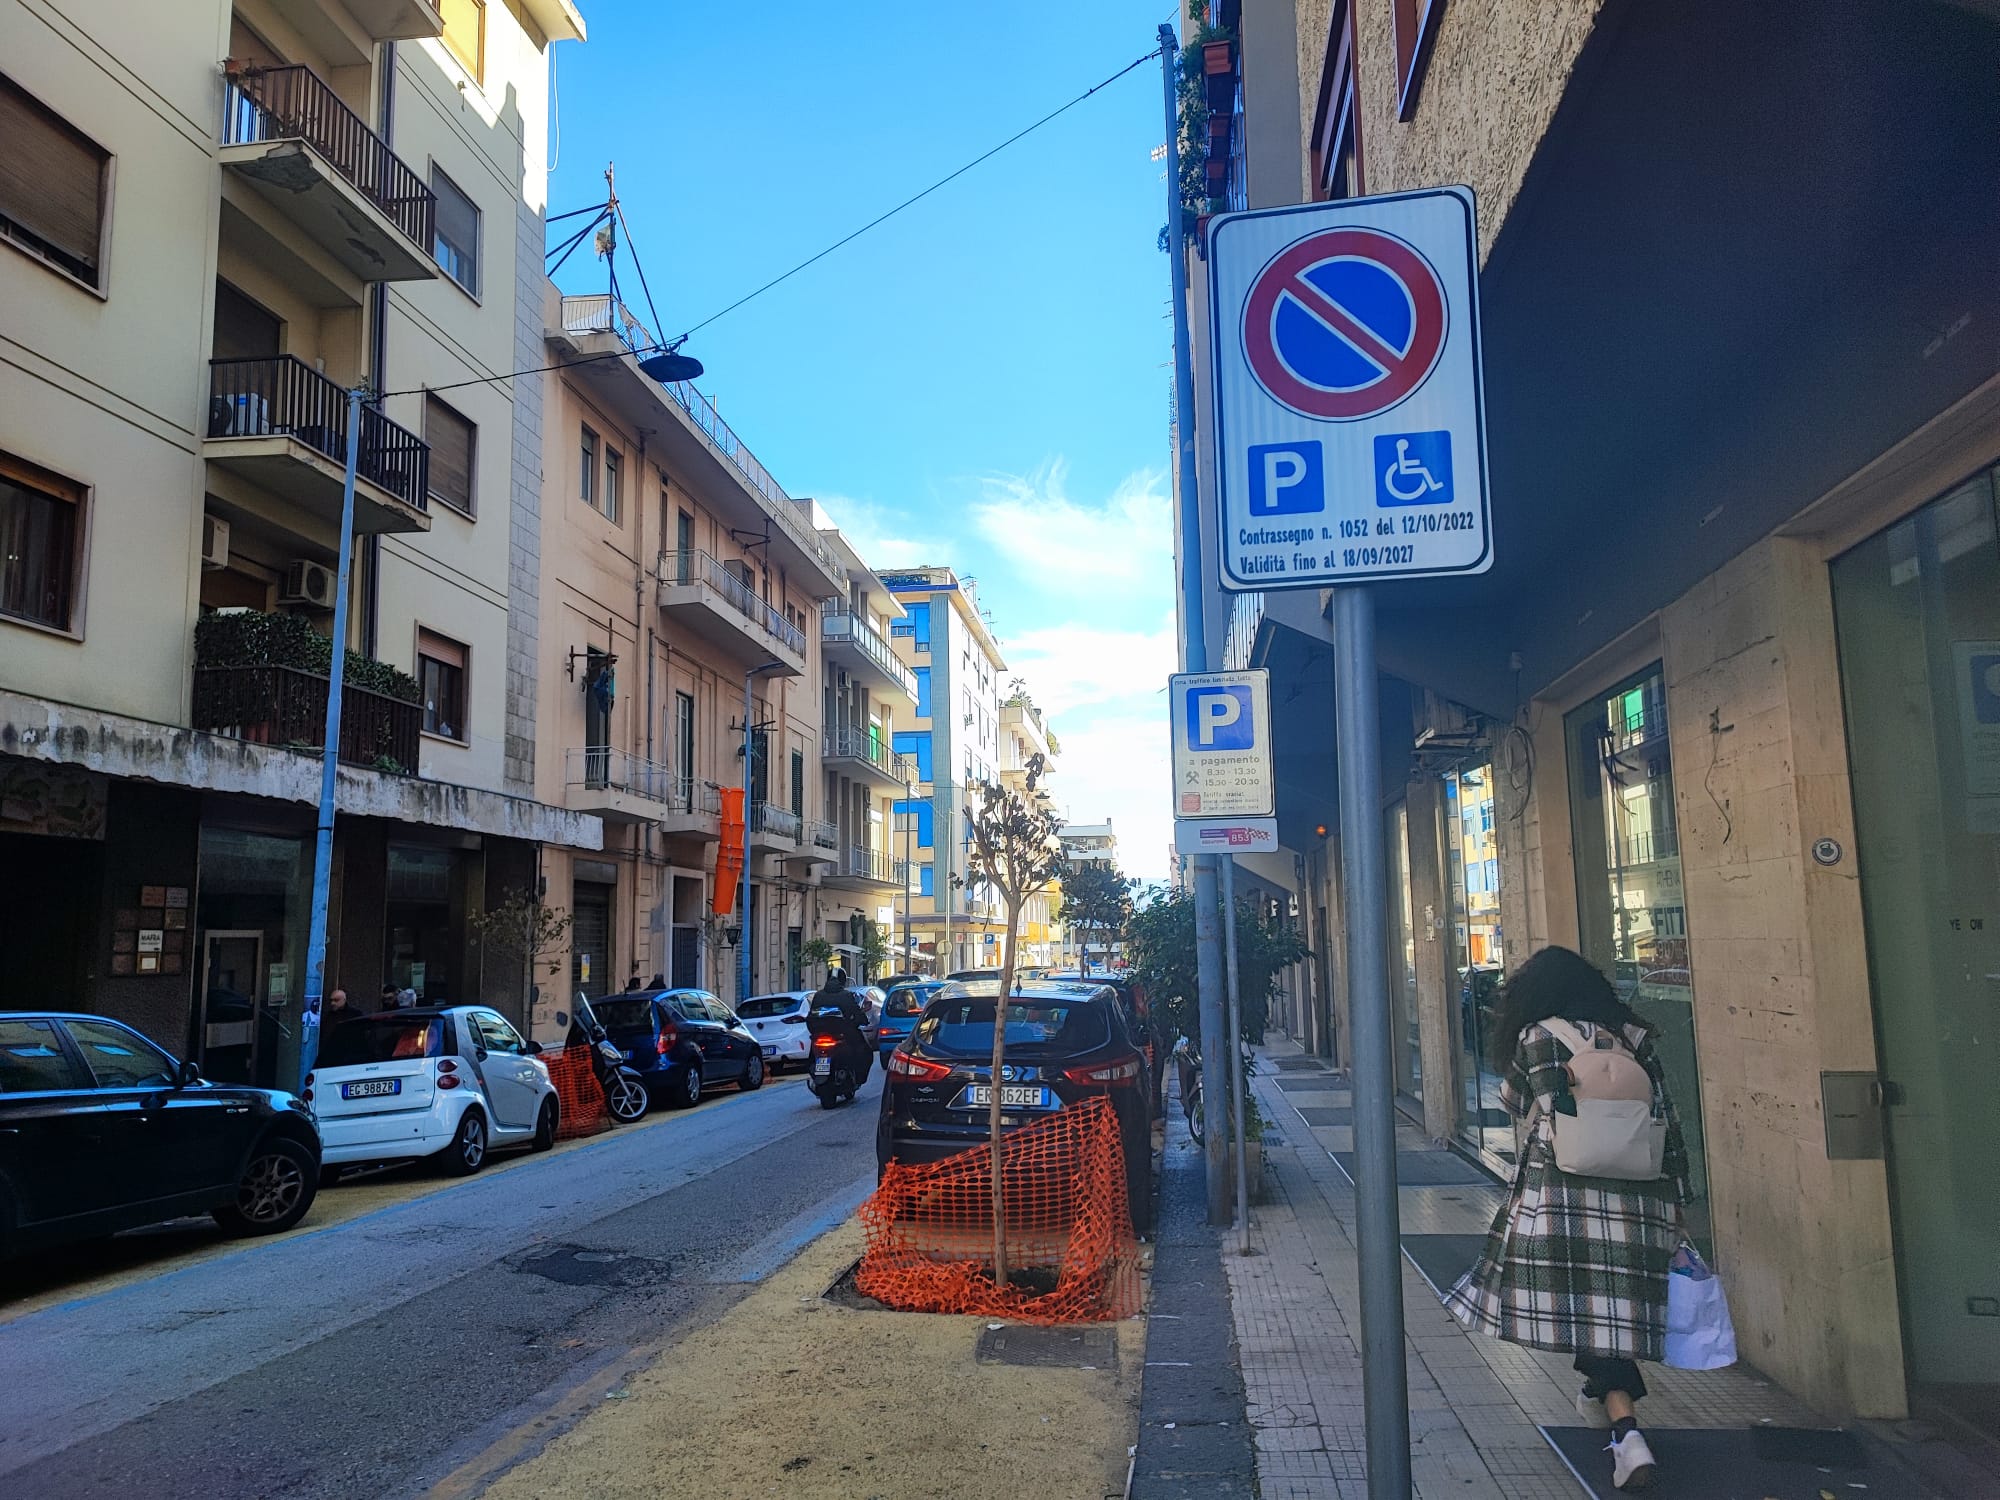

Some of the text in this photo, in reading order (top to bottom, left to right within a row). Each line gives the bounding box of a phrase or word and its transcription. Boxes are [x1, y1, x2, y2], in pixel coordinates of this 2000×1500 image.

[1264, 451, 1307, 508] P
[1239, 511, 1474, 546] Contrassegno n. 1052 del 12/10/2022
[1240, 544, 1414, 574] Validità fino al 18/09/2027
[1198, 693, 1241, 745] P
[1201, 755, 1260, 767] pagamento
[1235, 767, 1256, 775] 13.30
[1234, 777, 1260, 786] 20.30
[1231, 834, 1250, 843] 853
